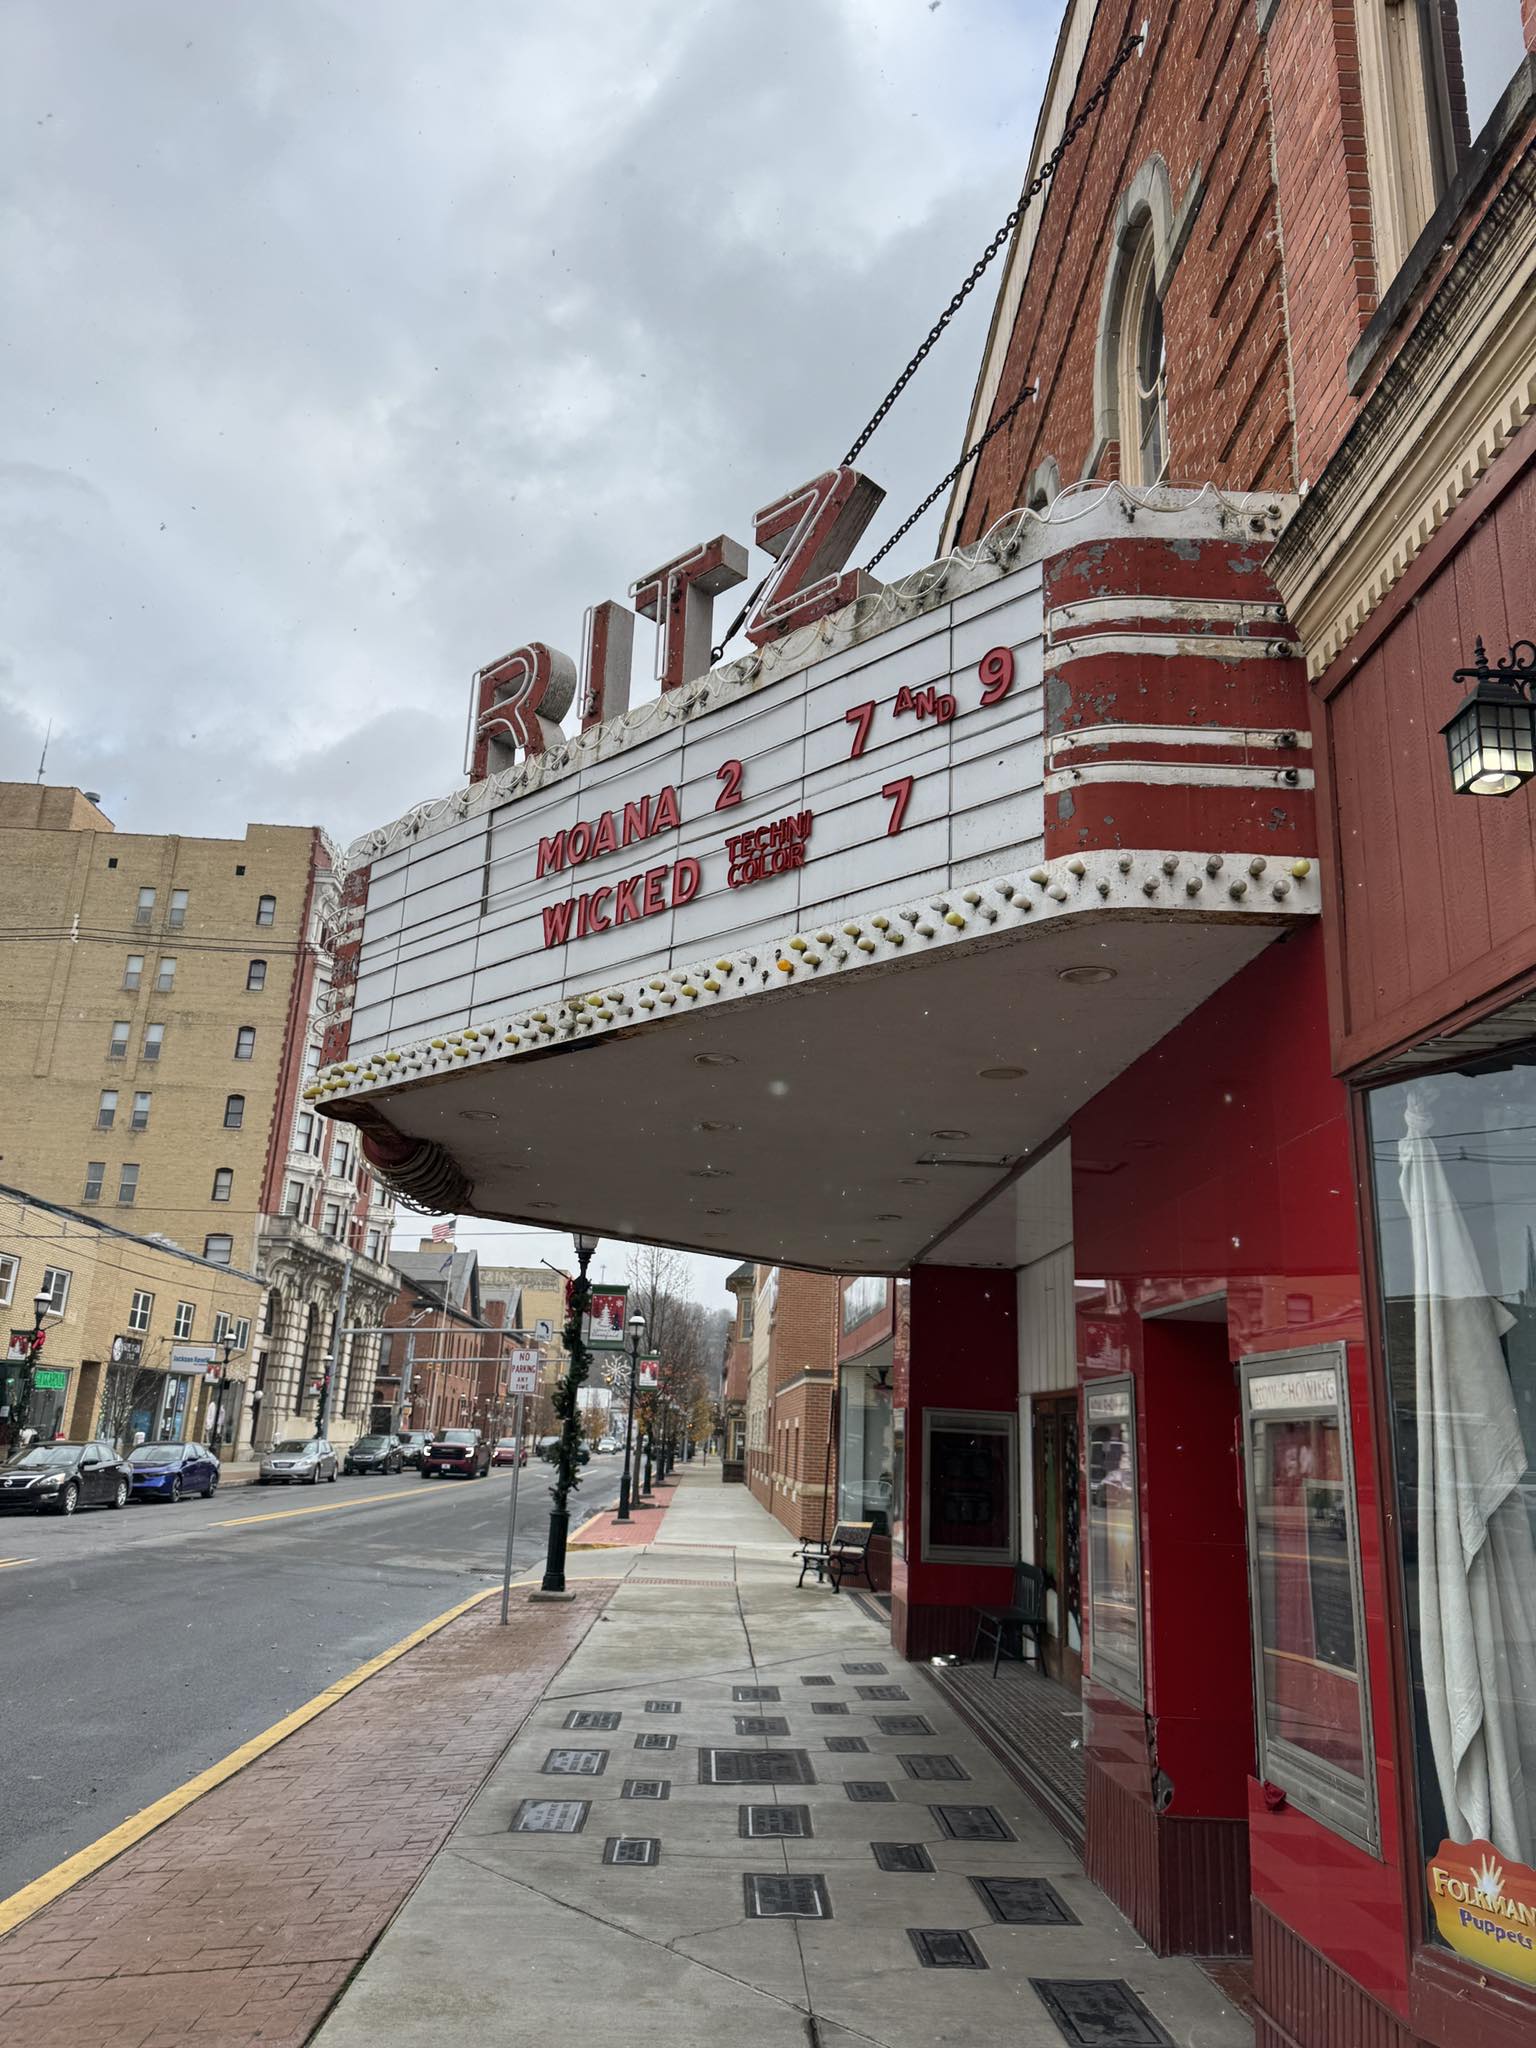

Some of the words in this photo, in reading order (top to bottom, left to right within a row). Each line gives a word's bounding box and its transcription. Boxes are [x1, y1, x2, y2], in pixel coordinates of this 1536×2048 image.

[464, 465, 886, 785] RITZ
[535, 786, 681, 880] MOANA
[714, 759, 744, 812] 2
[845, 700, 876, 759] 7
[893, 685, 957, 725] AND
[977, 645, 1015, 707] 9
[541, 856, 702, 950] WICKED
[725, 809, 813, 863] TECHNI
[881, 775, 915, 837] 7
[727, 842, 806, 888] COLOR
[512, 1364, 536, 1374] PARKING
[519, 1352, 530, 1361] NO
[1280, 1377, 1336, 1401] SHOWING
[1458, 1906, 1533, 1950] Puppets
